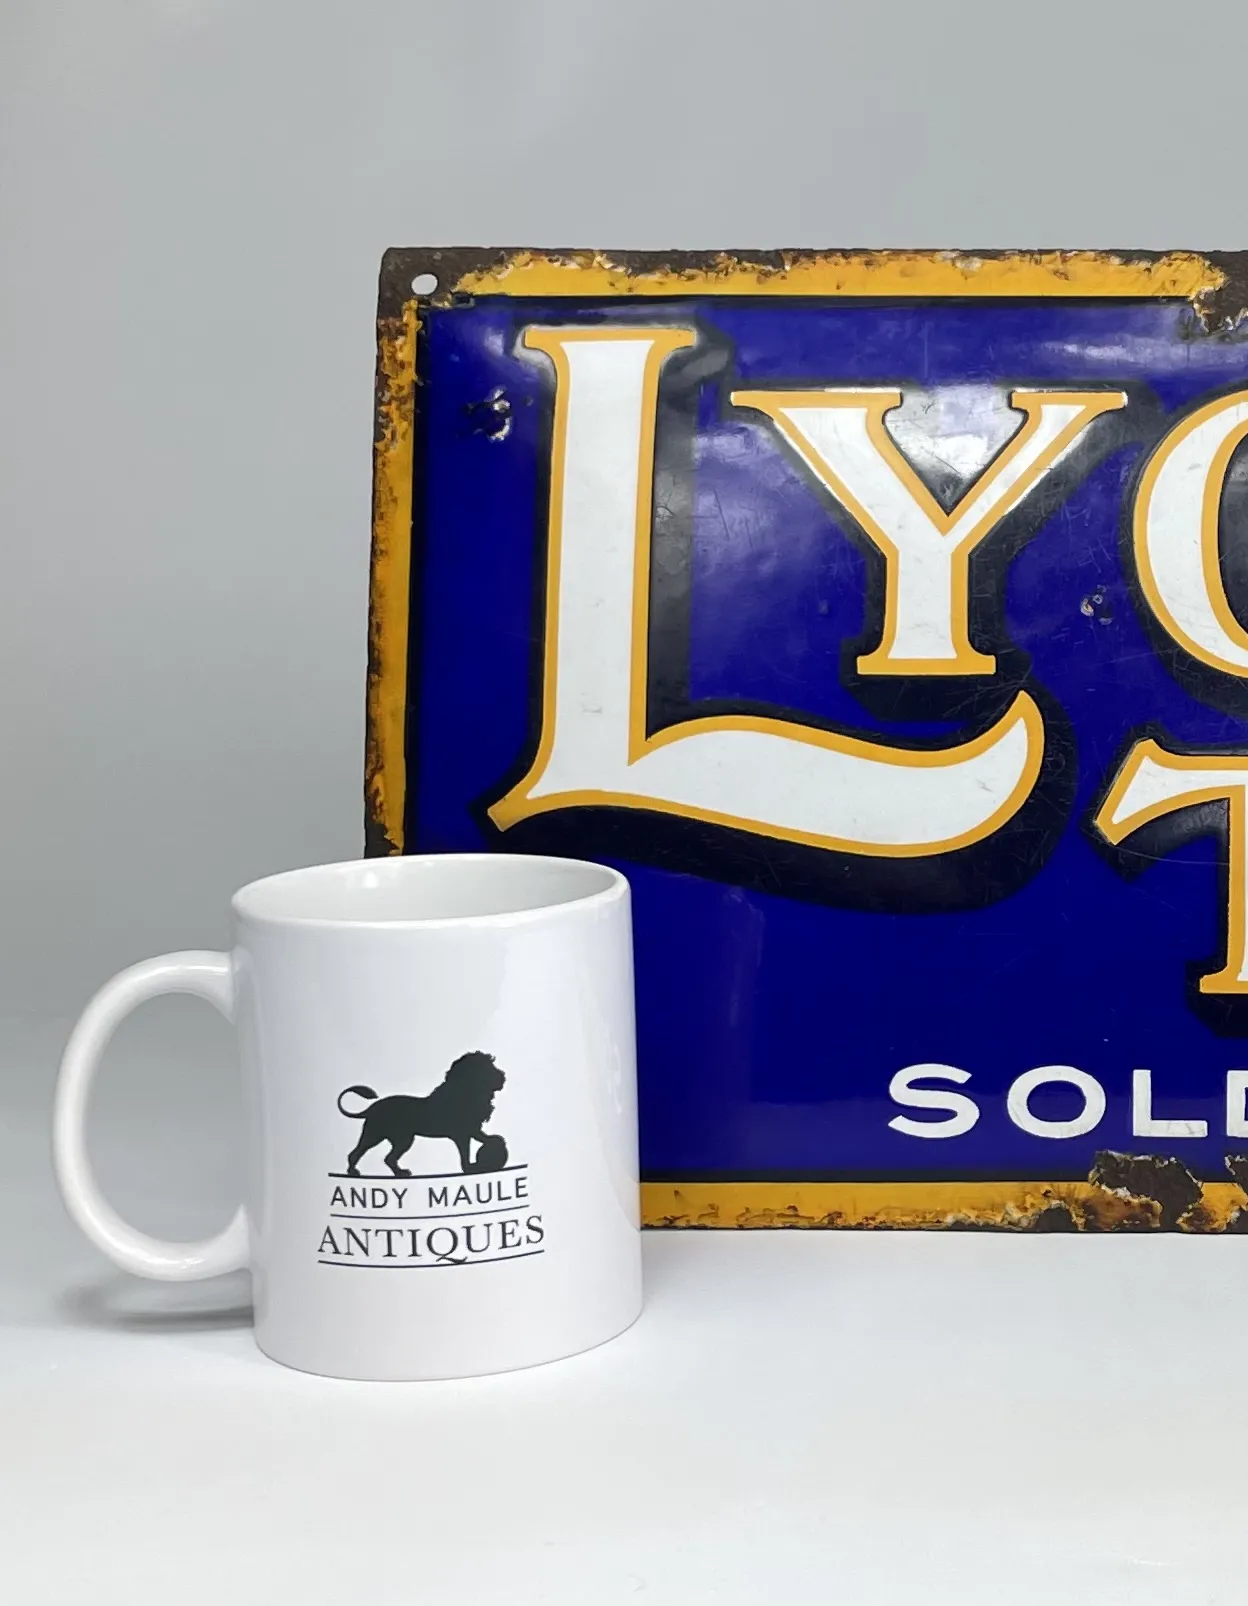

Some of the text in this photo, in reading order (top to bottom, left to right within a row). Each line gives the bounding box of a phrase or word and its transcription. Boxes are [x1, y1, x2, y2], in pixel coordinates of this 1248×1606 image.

[331, 1176, 529, 1209] ANDY MAULE
[317, 1214, 545, 1264] ANTIQUES
